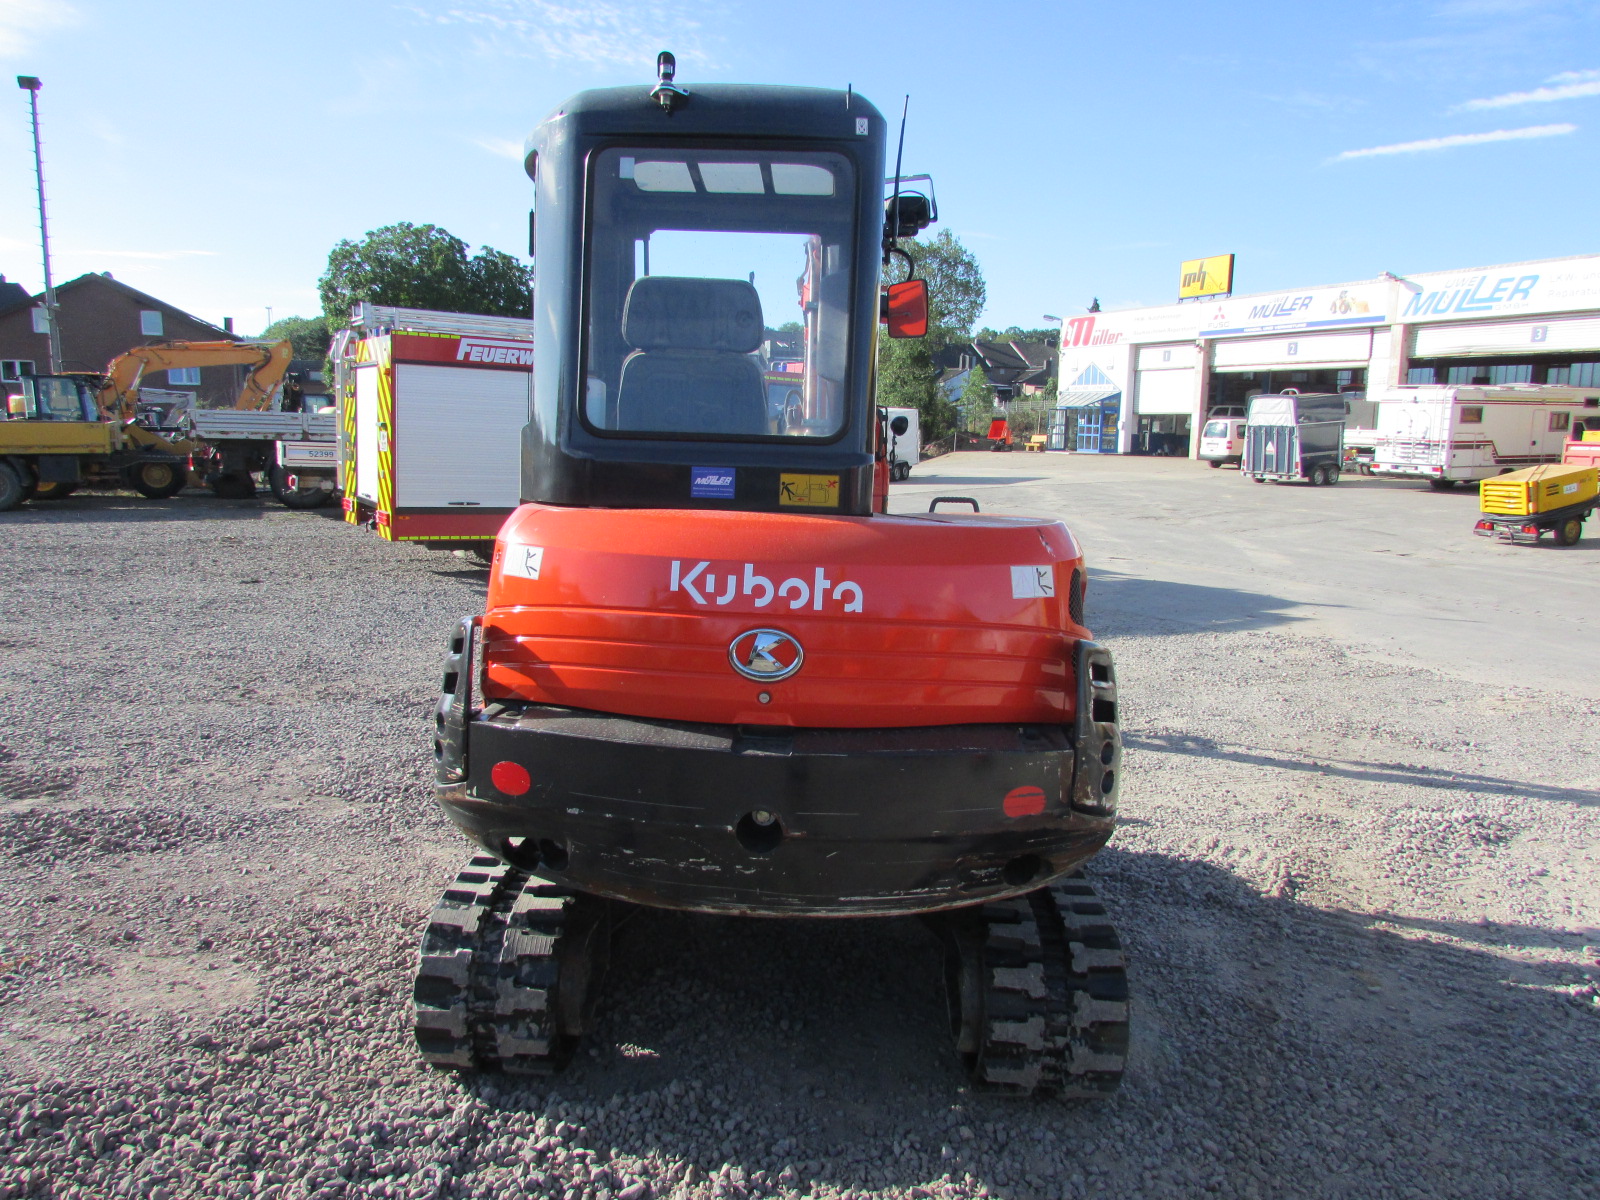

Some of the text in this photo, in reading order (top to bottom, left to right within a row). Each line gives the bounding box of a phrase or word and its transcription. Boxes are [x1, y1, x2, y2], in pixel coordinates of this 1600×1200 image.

[1445, 276, 1479, 288] UWE
[1534, 328, 1542, 340] 3
[1289, 344, 1296, 354] 2
[308, 450, 334, 458] 52399
[670, 560, 864, 613] Kubota
